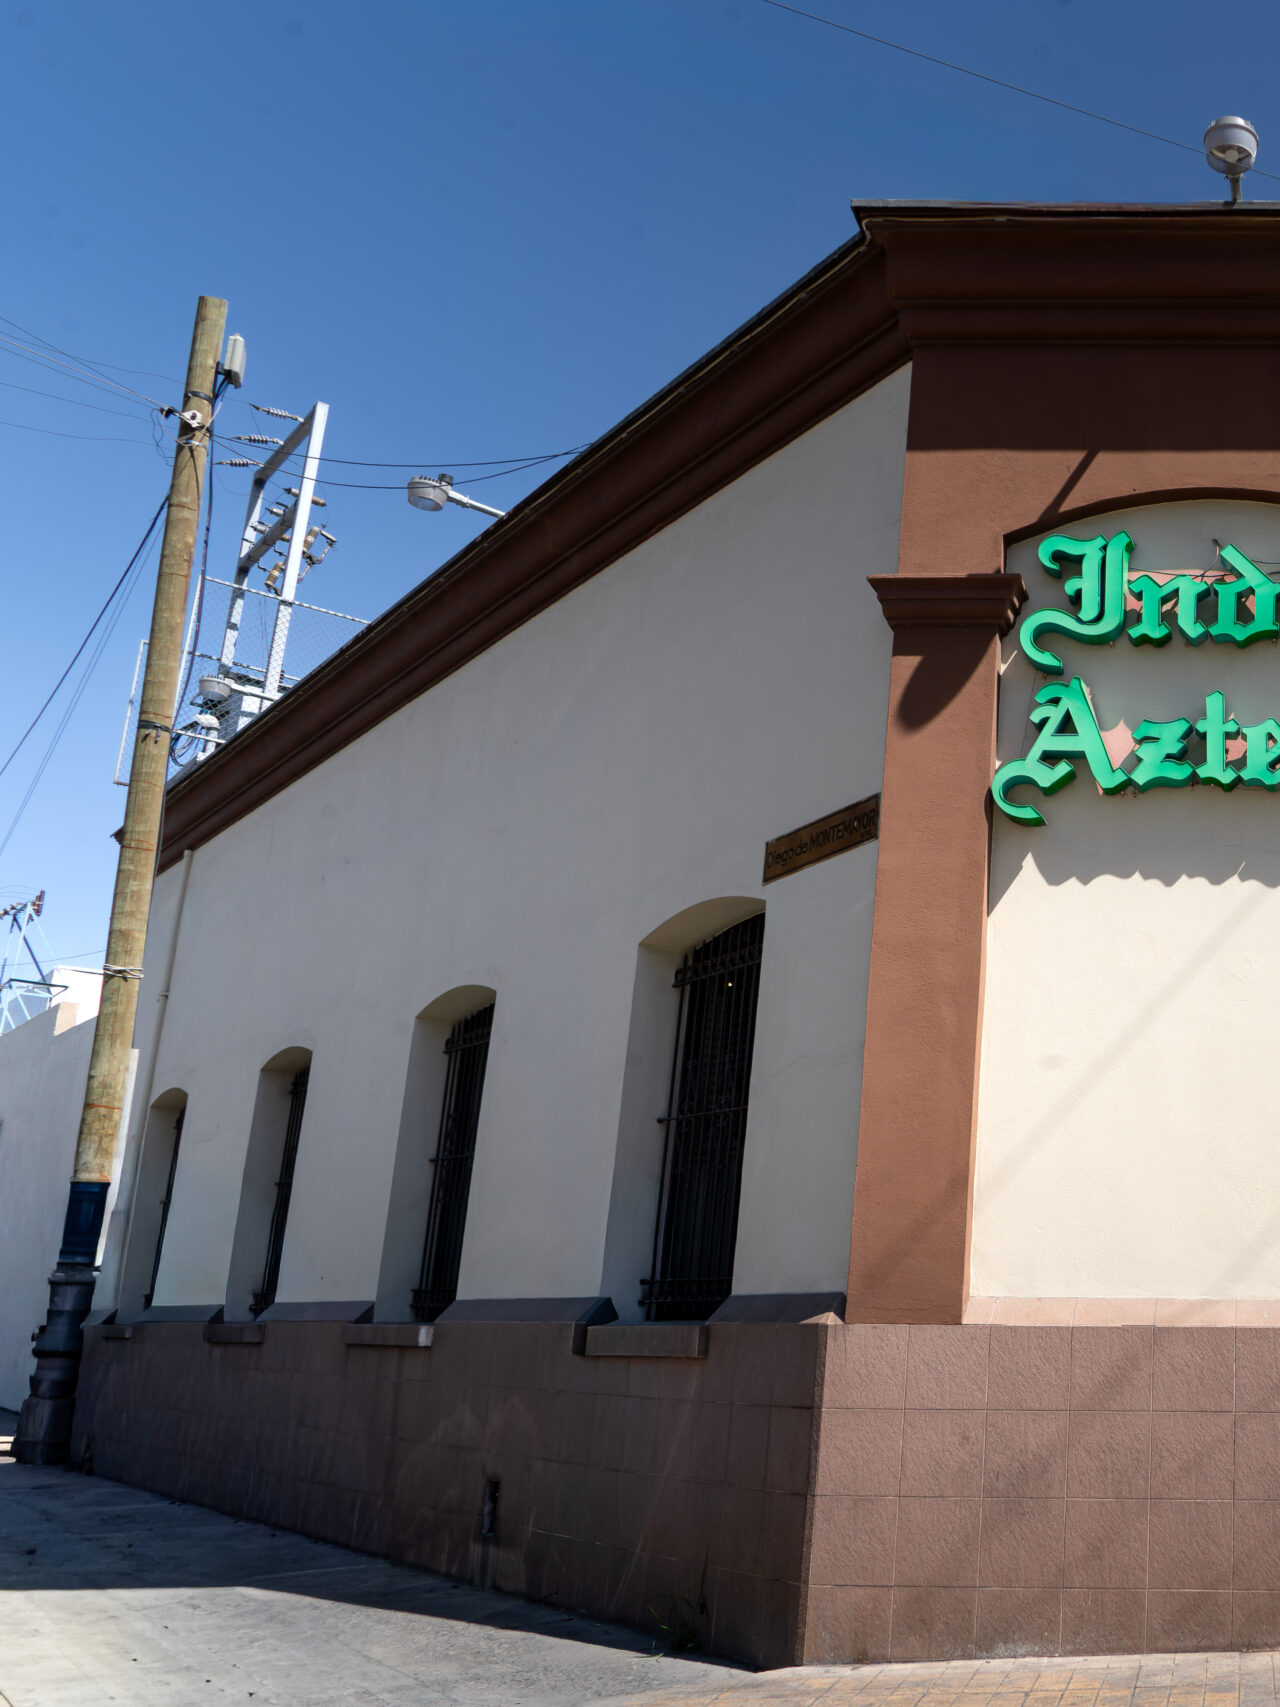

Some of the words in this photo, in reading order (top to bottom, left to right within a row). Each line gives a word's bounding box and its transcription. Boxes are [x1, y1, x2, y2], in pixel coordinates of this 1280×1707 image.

[766, 847, 795, 869] Diego
[796, 839, 809, 857] de
[809, 808, 877, 852] MONTEMAYOR
